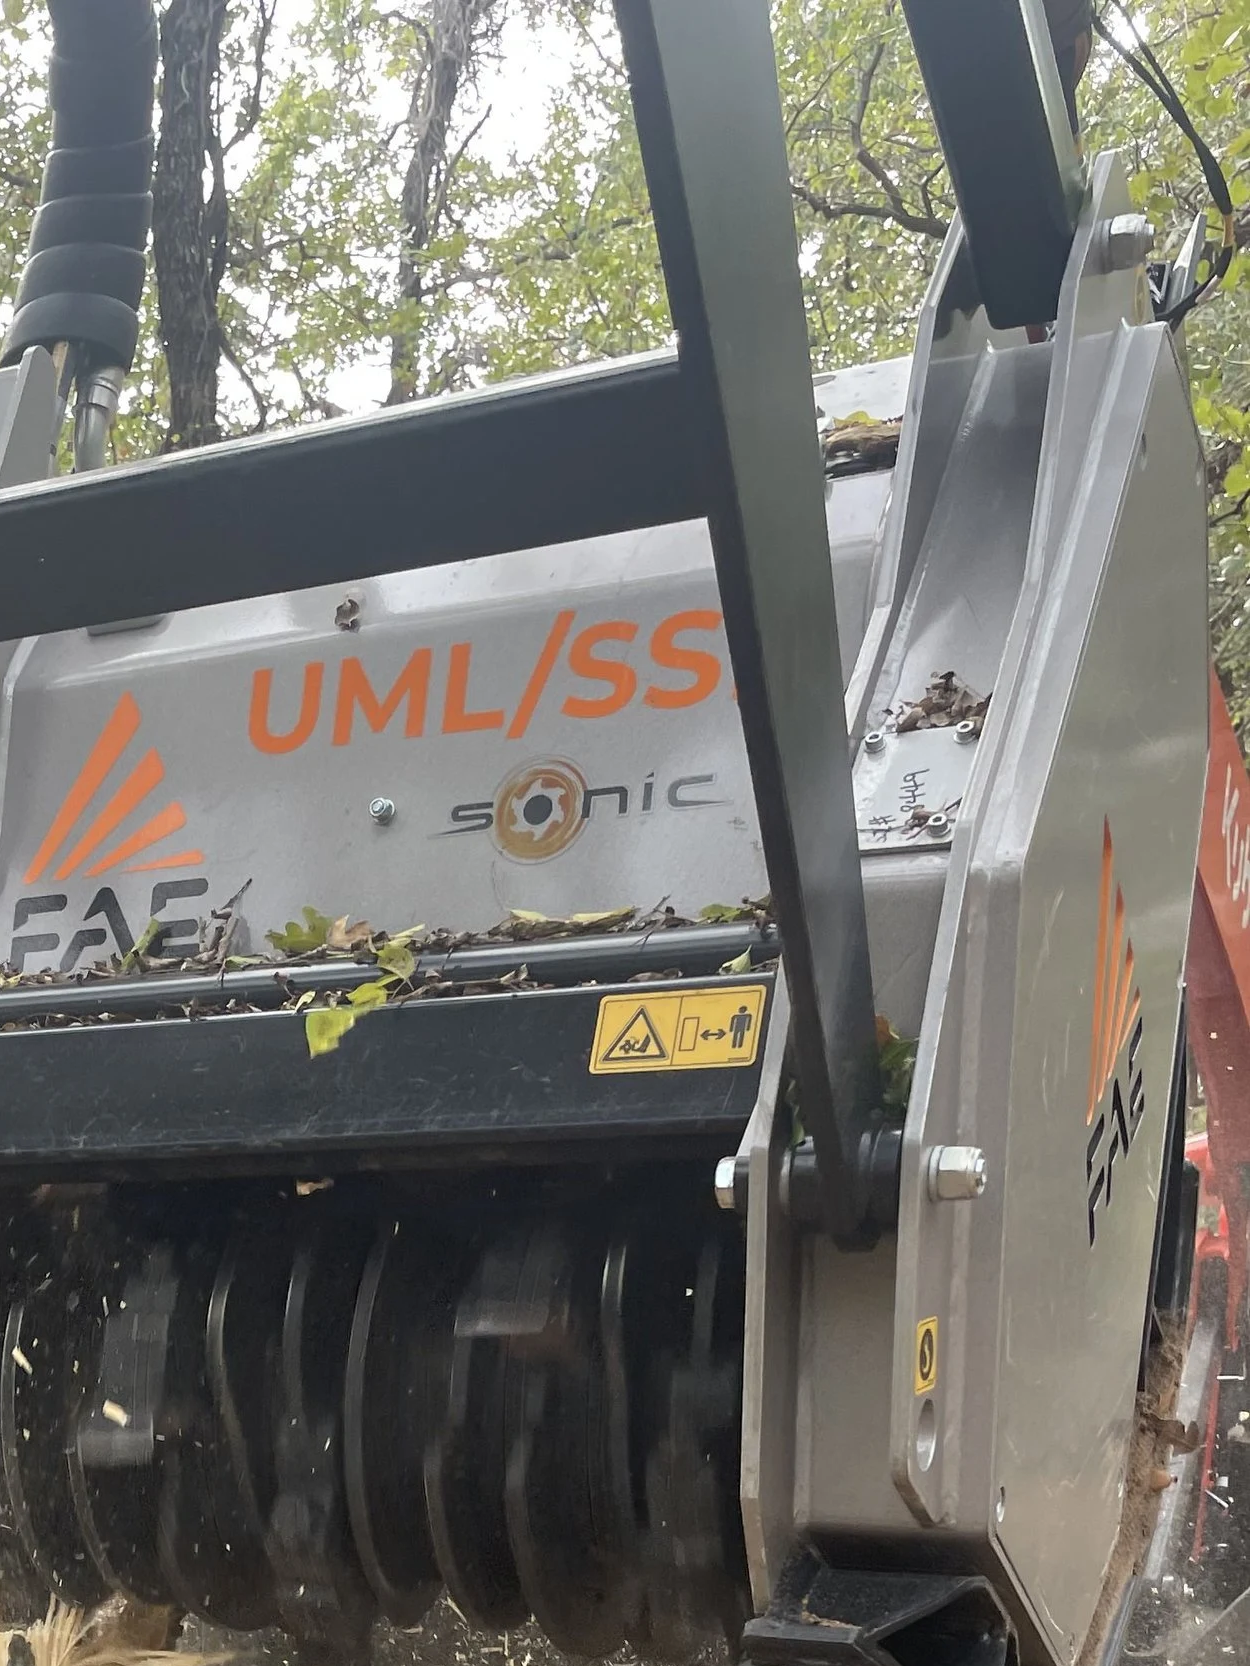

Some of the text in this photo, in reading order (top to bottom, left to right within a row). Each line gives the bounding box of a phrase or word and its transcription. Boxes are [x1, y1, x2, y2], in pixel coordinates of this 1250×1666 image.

[249, 609, 738, 754] UML/SS
[898, 768, 930, 813] 8449
[10, 878, 209, 972] FAE
[1087, 1016, 1144, 1248] FAE
